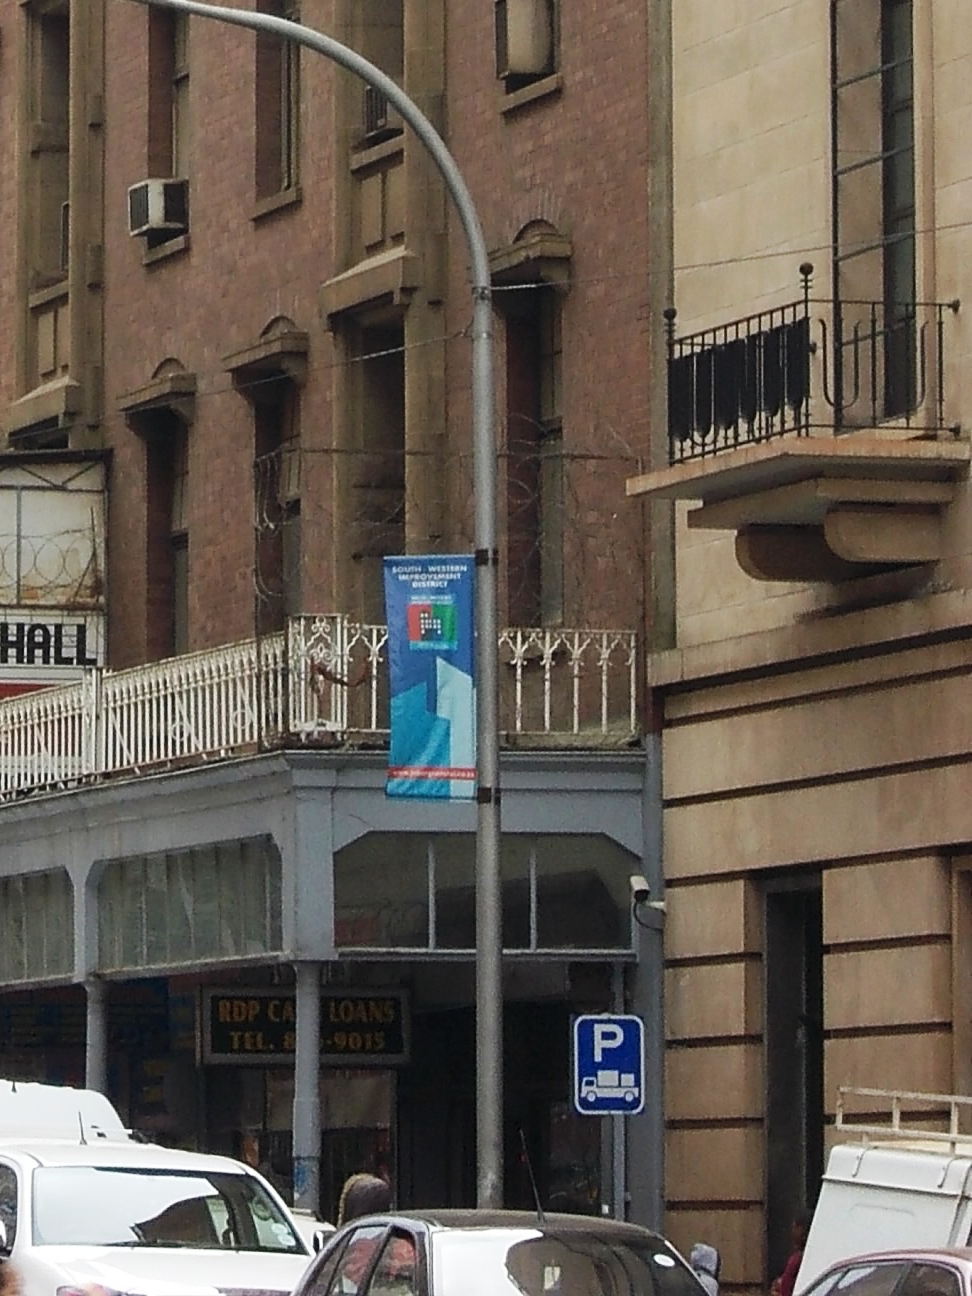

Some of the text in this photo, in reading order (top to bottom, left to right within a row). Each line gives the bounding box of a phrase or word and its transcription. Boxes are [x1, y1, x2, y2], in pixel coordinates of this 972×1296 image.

[398, 573, 461, 581] IMPROVEMENT
[428, 565, 467, 573] WESTERN
[411, 580, 448, 588] DISTRICT
[0, 621, 98, 666] HALL
[218, 998, 261, 1022] RDP
[328, 999, 395, 1022] LOANS
[230, 1031, 385, 1050] TEL. 8-9015
[593, 1023, 623, 1062] P
